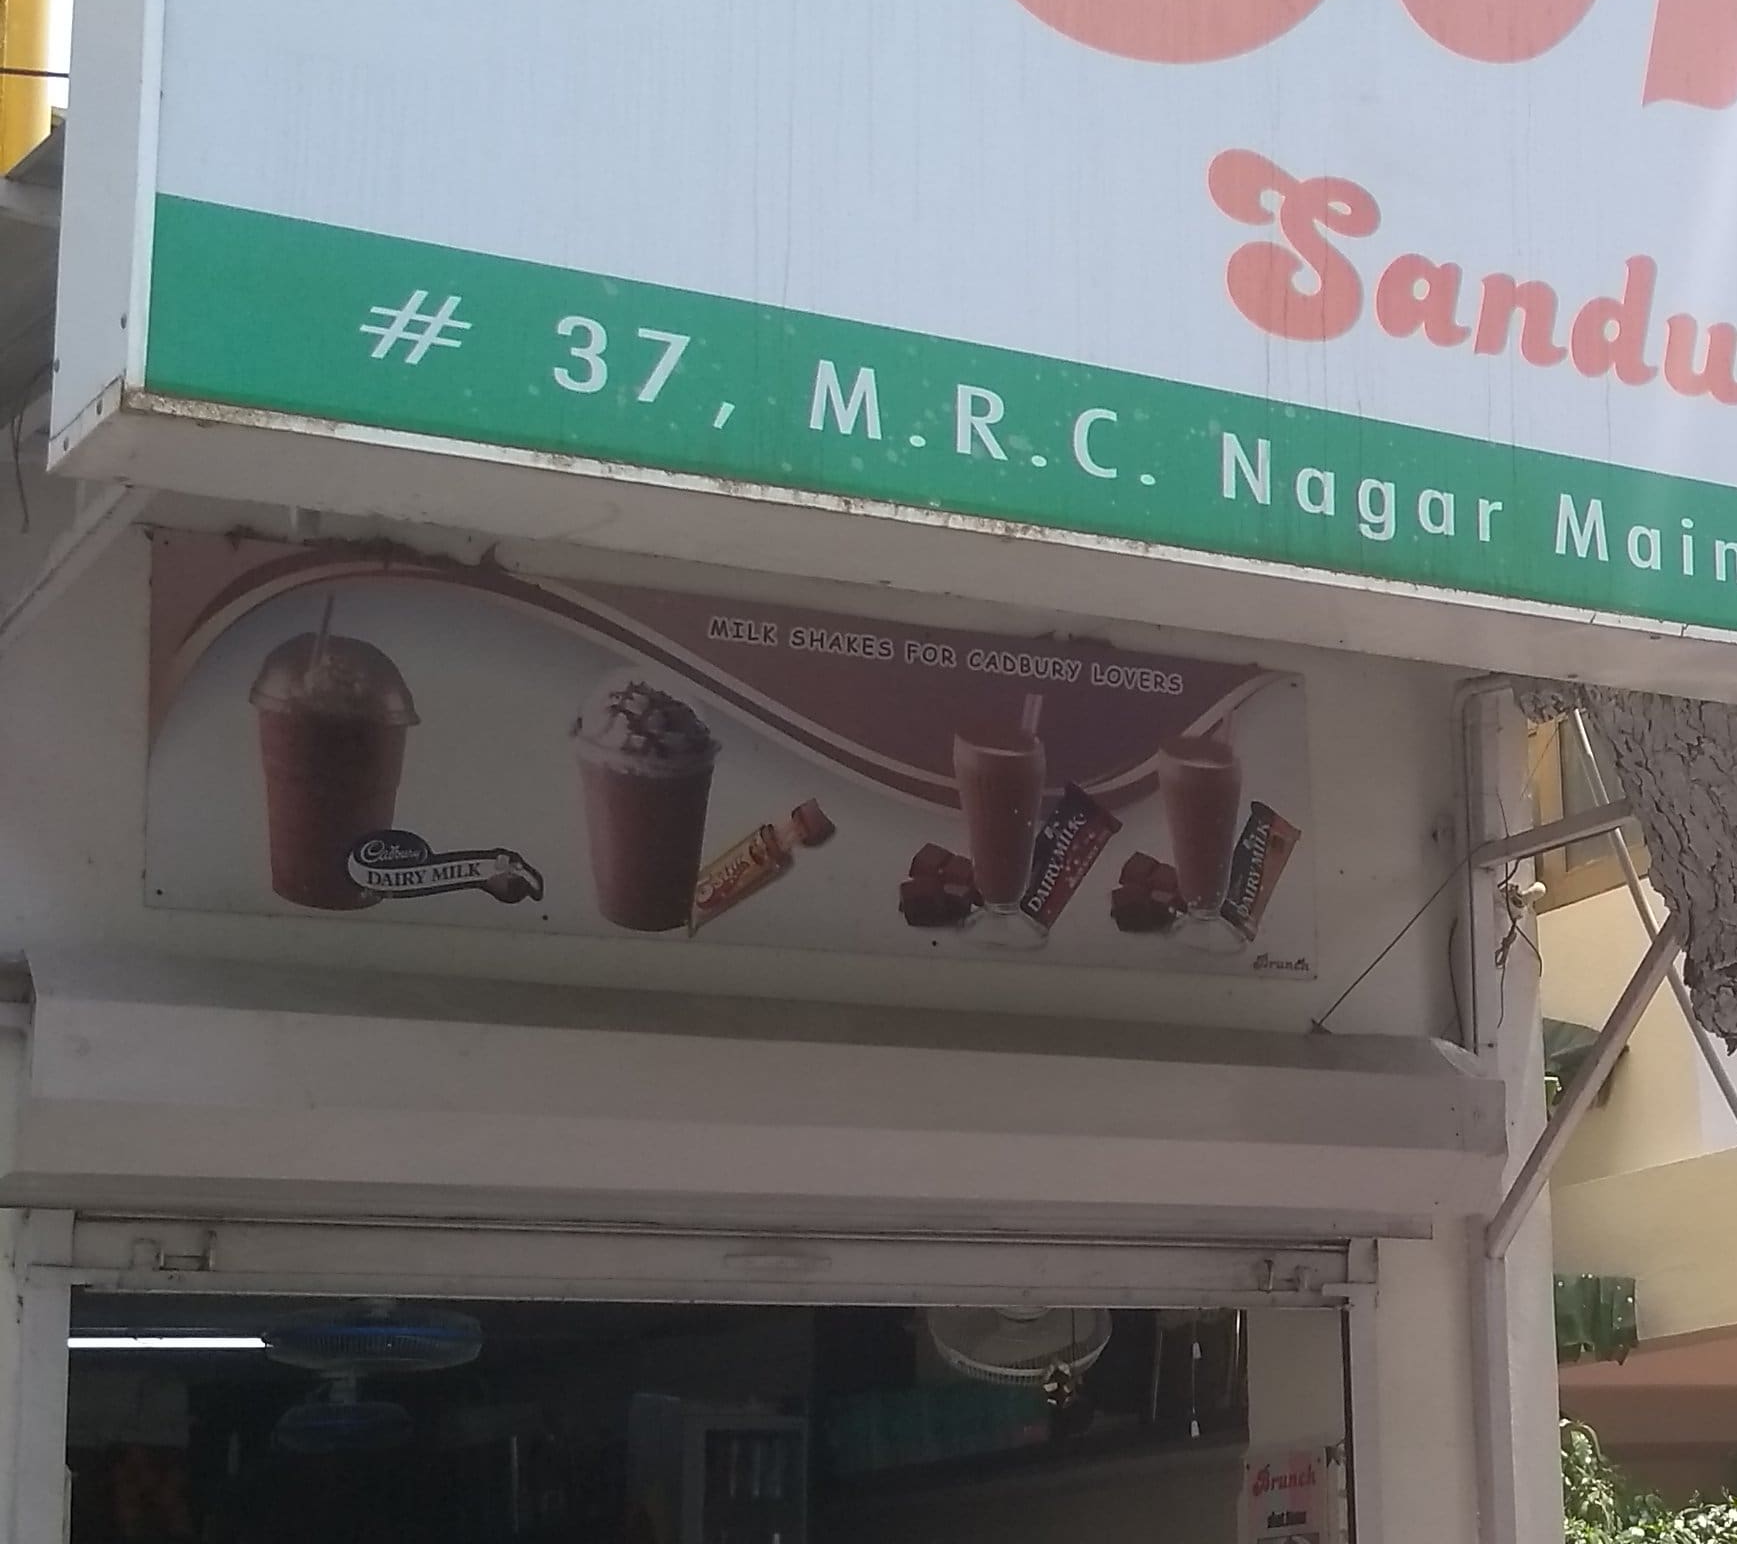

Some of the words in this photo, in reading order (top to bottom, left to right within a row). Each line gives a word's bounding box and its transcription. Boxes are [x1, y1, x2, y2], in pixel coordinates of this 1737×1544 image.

[358, 288, 474, 366] #
[552, 313, 737, 430] 37,
[809, 359, 1157, 487] M.R.C.
[1221, 432, 1504, 543] Nagar
[709, 616, 778, 647] MILK
[790, 626, 895, 659] SHAKES
[905, 640, 956, 667] FOR
[968, 649, 1081, 684] CADBURY
[1091, 663, 1185, 695] LOVERS
[367, 870, 426, 887] DAIRY
[431, 862, 481, 882] MILK
[1028, 860, 1064, 913] DAIRY
[1053, 813, 1088, 859] MILK
[1253, 952, 1310, 972] Brunch
